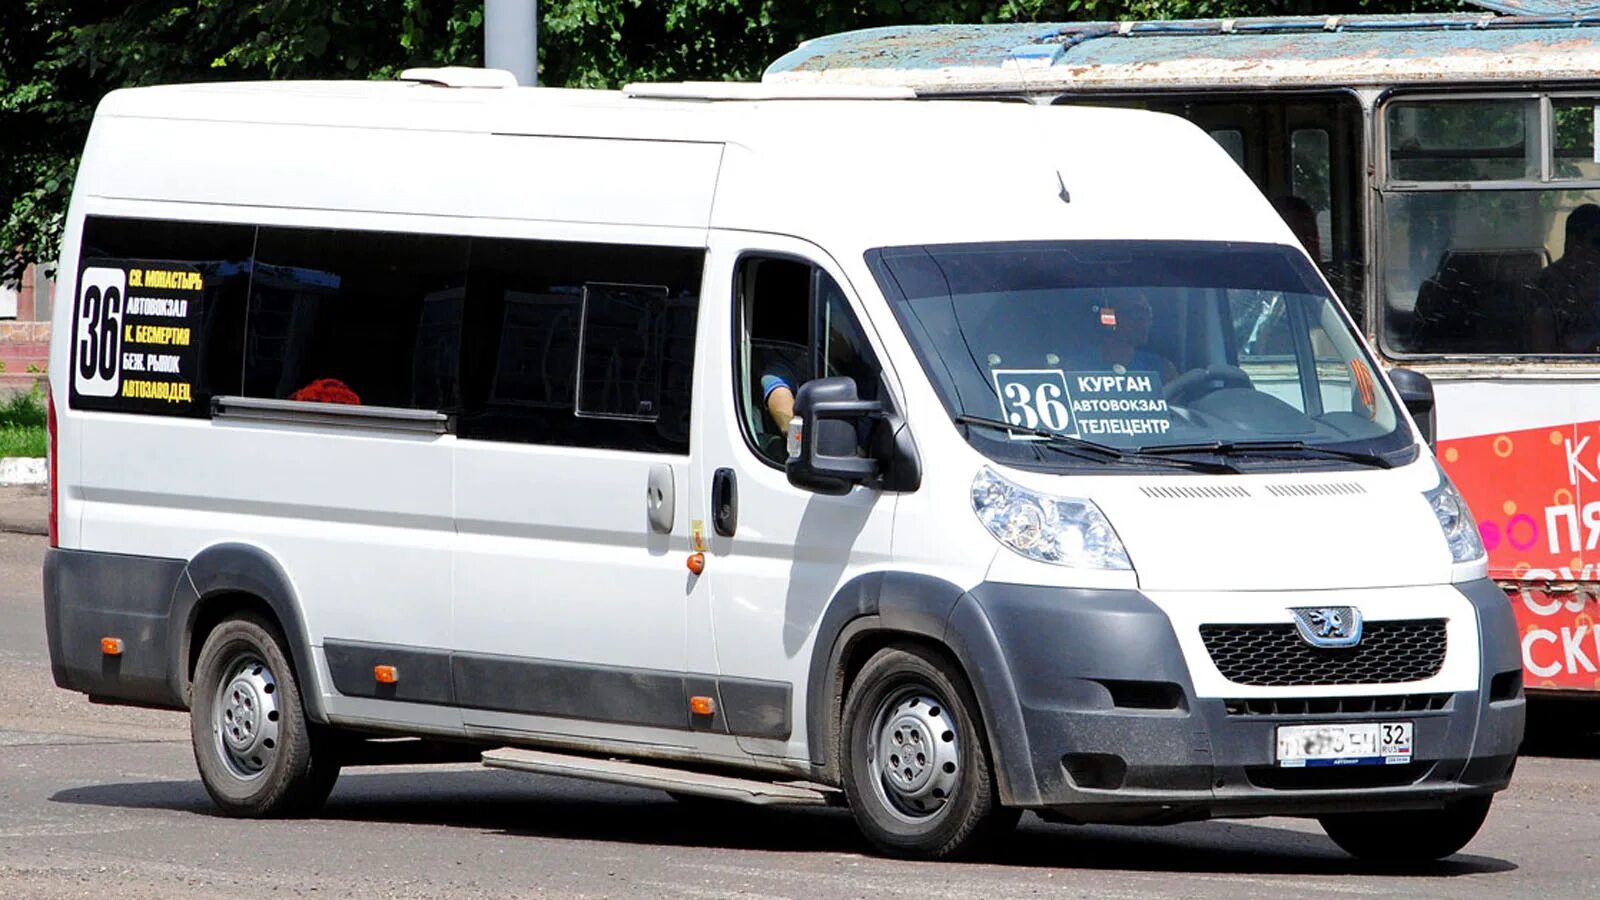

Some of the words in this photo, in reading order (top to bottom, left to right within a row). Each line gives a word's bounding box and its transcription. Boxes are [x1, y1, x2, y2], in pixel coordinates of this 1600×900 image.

[128, 269, 143, 287] СВ.
[145, 270, 203, 290] МОНАСТЫРЬ
[126, 296, 188, 317] АВТОВОКЗАЛ
[79, 284, 121, 381] 36
[124, 325, 134, 343] К.
[136, 325, 190, 346] БЕСМЕРТИЯ
[122, 353, 145, 370] БЕЖ.
[147, 354, 181, 373] РЫНОК
[122, 379, 192, 403] АВТОЗАВОДЕЦ
[1078, 376, 1152, 392] КУРГАН
[1004, 382, 1069, 432] 36
[1073, 399, 1168, 412] АВТОВОКЗАЛ
[1079, 419, 1170, 437] ТЕЛЕЦЕНТР
[1564, 436, 1600, 485] К
[1521, 563, 1600, 616] СУ
[1382, 725, 1404, 745] 32
